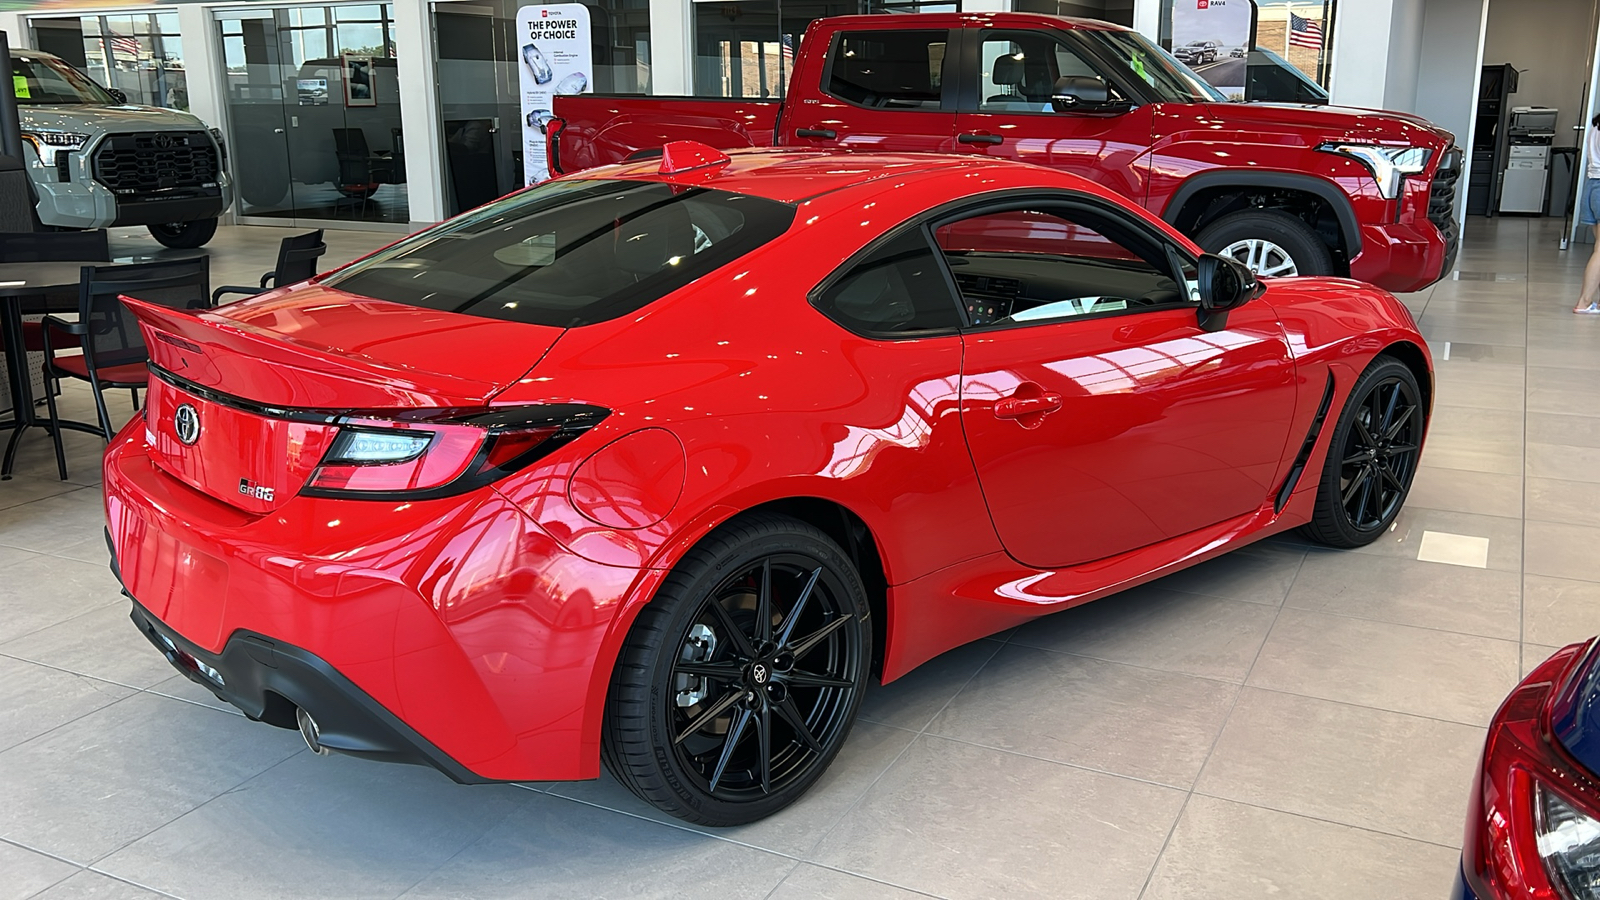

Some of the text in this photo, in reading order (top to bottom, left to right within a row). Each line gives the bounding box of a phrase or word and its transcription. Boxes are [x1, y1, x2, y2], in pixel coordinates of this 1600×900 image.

[528, 20, 577, 30] THE POWER
[530, 30, 576, 40] OF CHOICE
[239, 485, 275, 501] GR86
[839, 563, 867, 613] MICHELIN
[656, 749, 692, 800] MICHELIN
